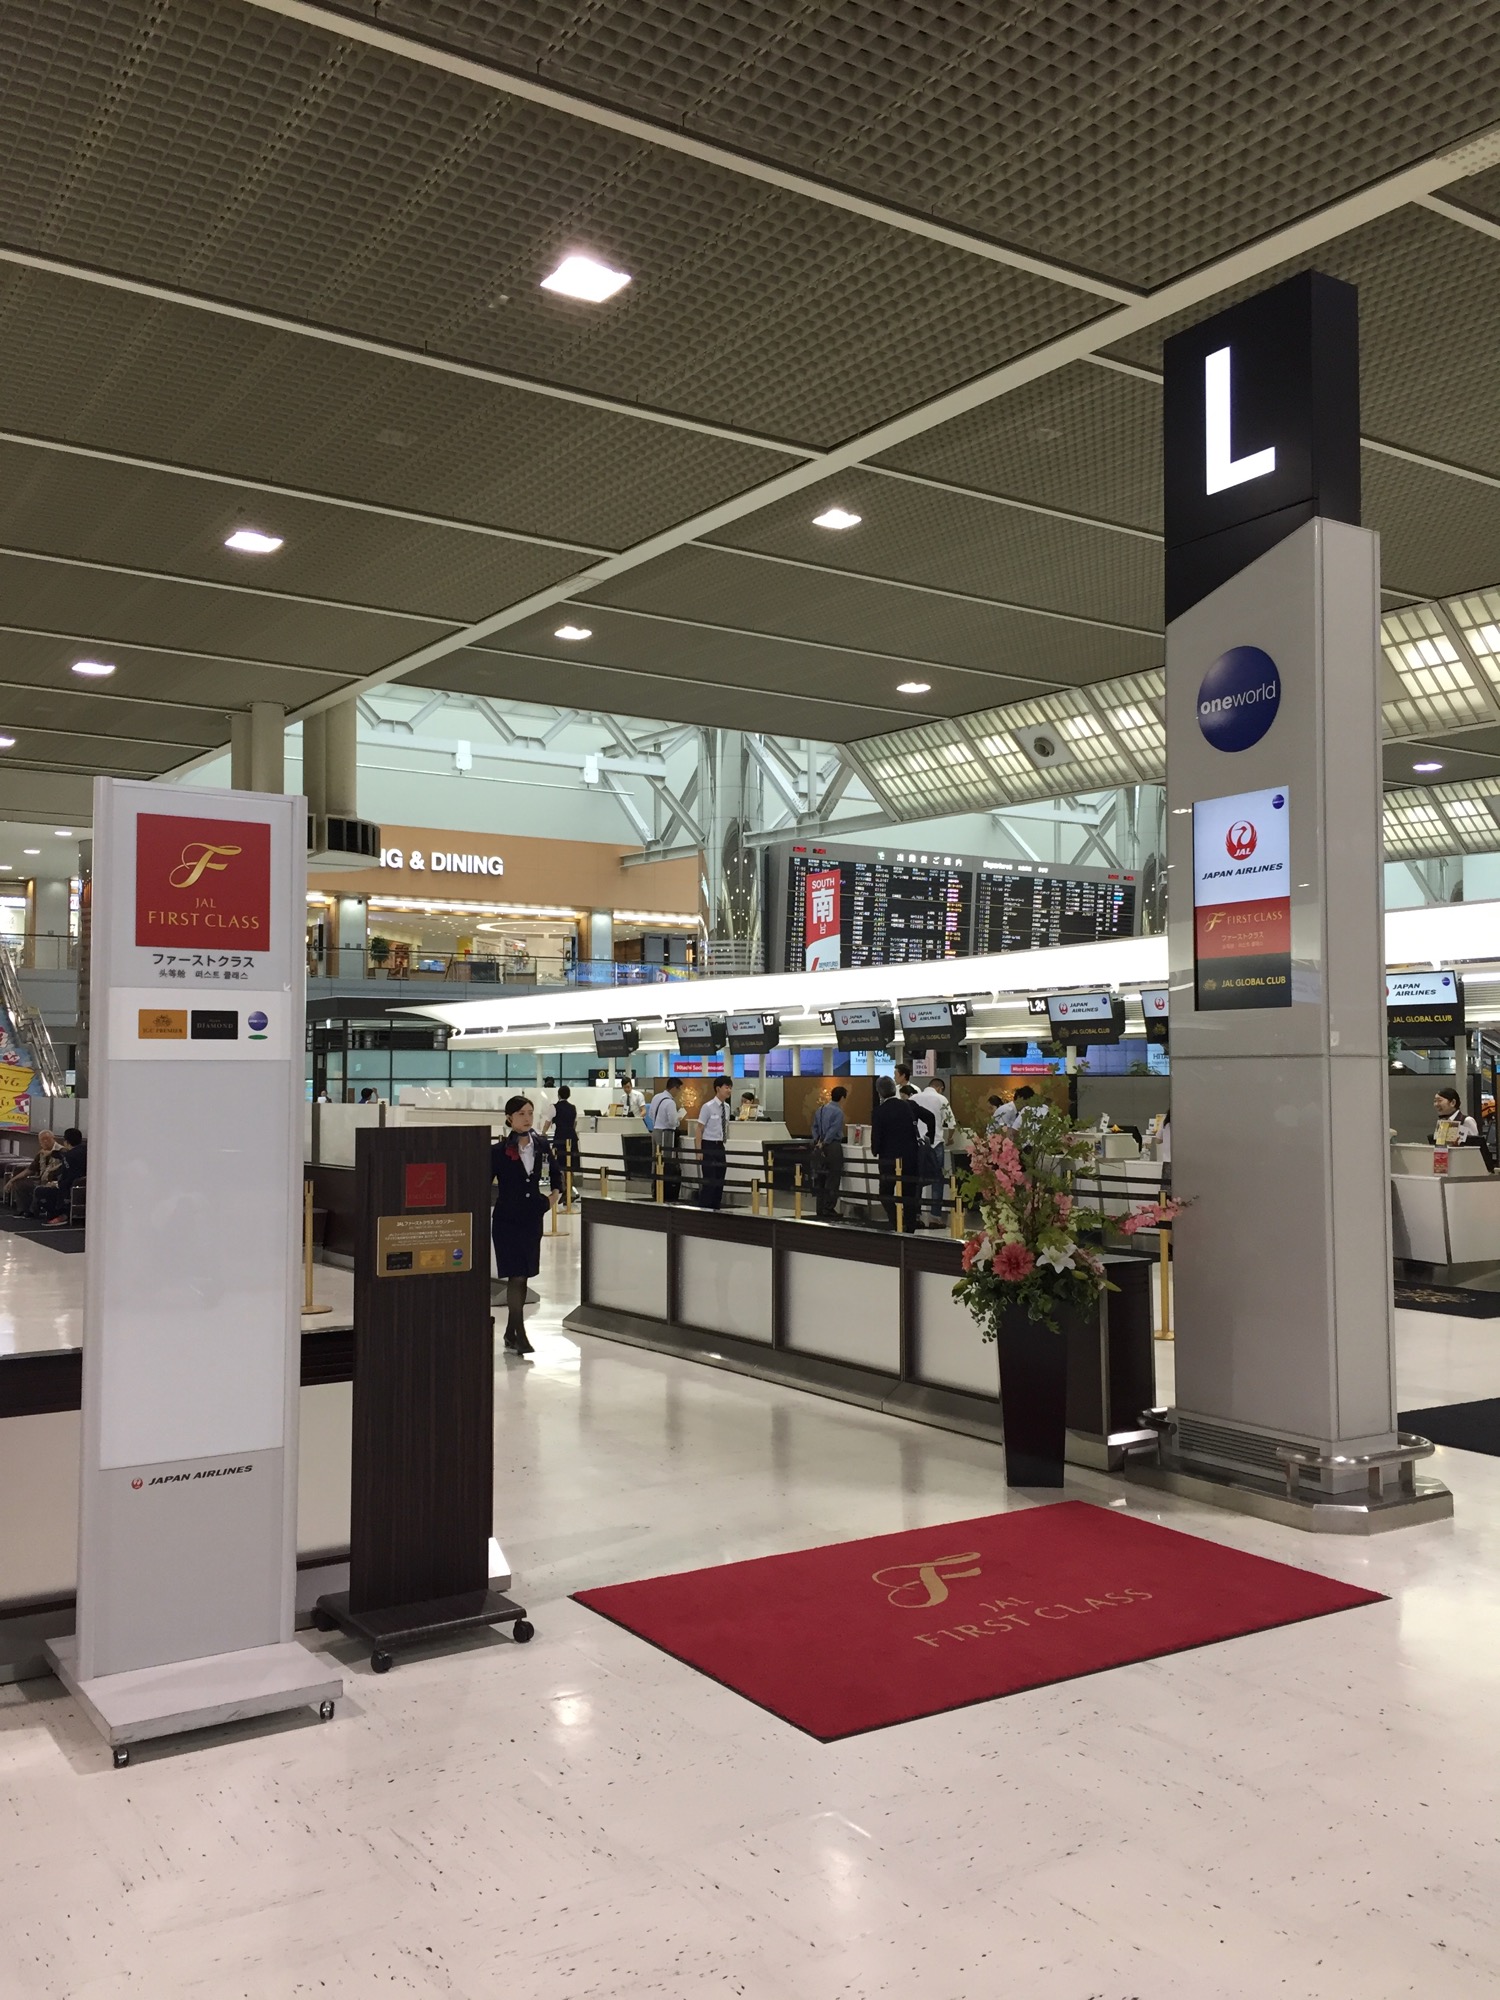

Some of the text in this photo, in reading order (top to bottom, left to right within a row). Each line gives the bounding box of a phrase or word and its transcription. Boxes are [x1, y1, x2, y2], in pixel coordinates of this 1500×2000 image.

[1205, 346, 1276, 495] L
[1200, 680, 1276, 715] oneworld
[1234, 848, 1251, 857] JAL
[410, 851, 425, 870] &
[431, 852, 504, 875] DINING
[1202, 863, 1283, 880] JAPAN AIRLINES
[812, 877, 835, 890] SOUTH
[195, 897, 216, 908] JAL
[812, 888, 835, 924] 南
[148, 911, 260, 930] FIRST CLASS
[1227, 913, 1251, 924] FIRST
[1254, 911, 1283, 922] CLASS
[152, 953, 255, 968] ファーストクラス
[1222, 976, 1287, 988] JAL GLOBAL CLUB
[1392, 982, 1421, 990] JAPAN
[1395, 989, 1437, 997] AIRLINES
[951, 1003, 967, 1015] L25
[1029, 1000, 1046, 1012] L24
[1405, 1015, 1433, 1023] GLOBAL
[1434, 1014, 1453, 1022] CLUB
[149, 1464, 253, 1486] JAPAN AIRLINES
[979, 1596, 1032, 1613] JAL
[913, 1587, 1153, 1648] FIRST CLASS
